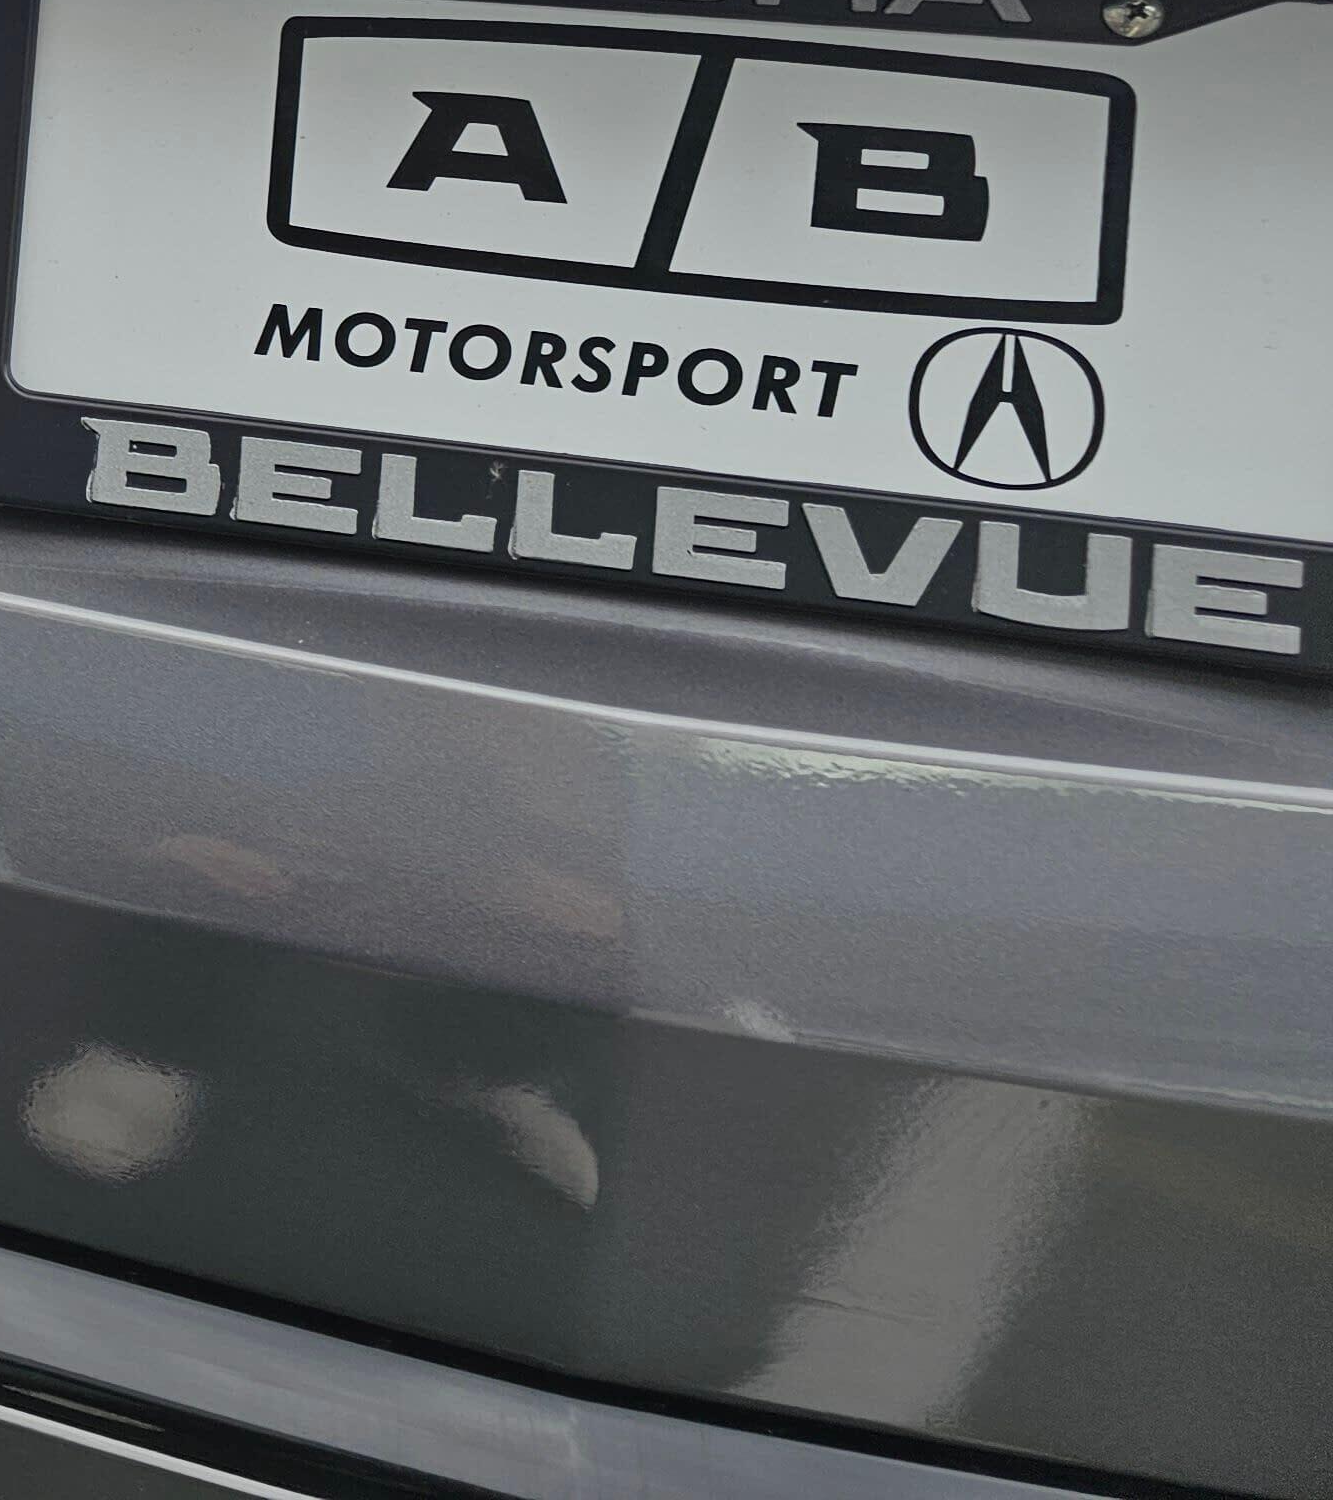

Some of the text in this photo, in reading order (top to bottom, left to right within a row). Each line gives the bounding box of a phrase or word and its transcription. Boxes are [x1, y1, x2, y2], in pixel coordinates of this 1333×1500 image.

[386, 91, 990, 242] A B
[253, 303, 859, 418] MOTORSPORT
[80, 416, 1304, 655] BELLEVUE
